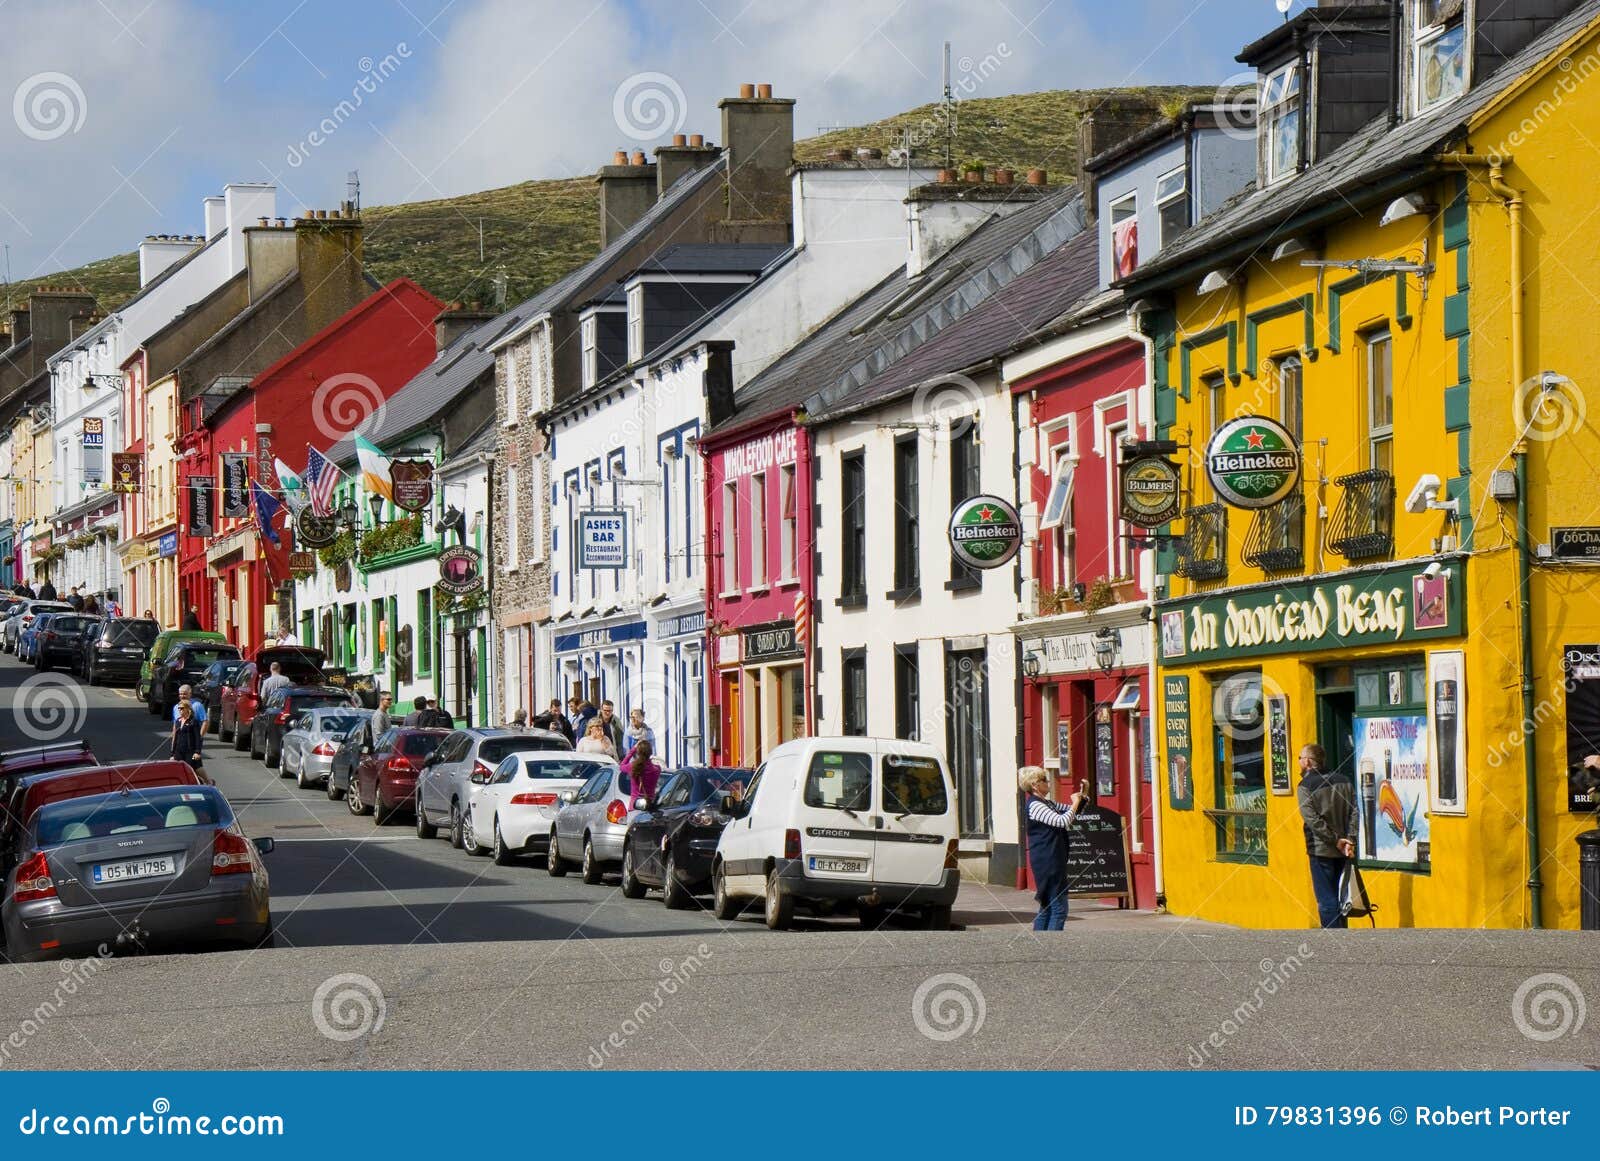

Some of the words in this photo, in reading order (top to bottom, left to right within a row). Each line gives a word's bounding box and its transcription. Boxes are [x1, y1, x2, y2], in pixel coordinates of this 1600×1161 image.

[85, 434, 103, 443] AIB
[724, 434, 774, 480] WHOLEFOOD
[775, 427, 797, 465] CAFE
[1215, 454, 1294, 471] Heineken
[1128, 480, 1174, 491] BULMERS
[586, 520, 621, 530] ASHE'S
[592, 533, 615, 542] BAR
[956, 526, 1017, 539] Heineken
[585, 544, 621, 553] RESTAURANT
[1046, 639, 1060, 661] The
[1369, 721, 1404, 739] GUINNESS
[107, 860, 168, 879] 05-WW-1796
[817, 860, 861, 871] 01-KY-2884
